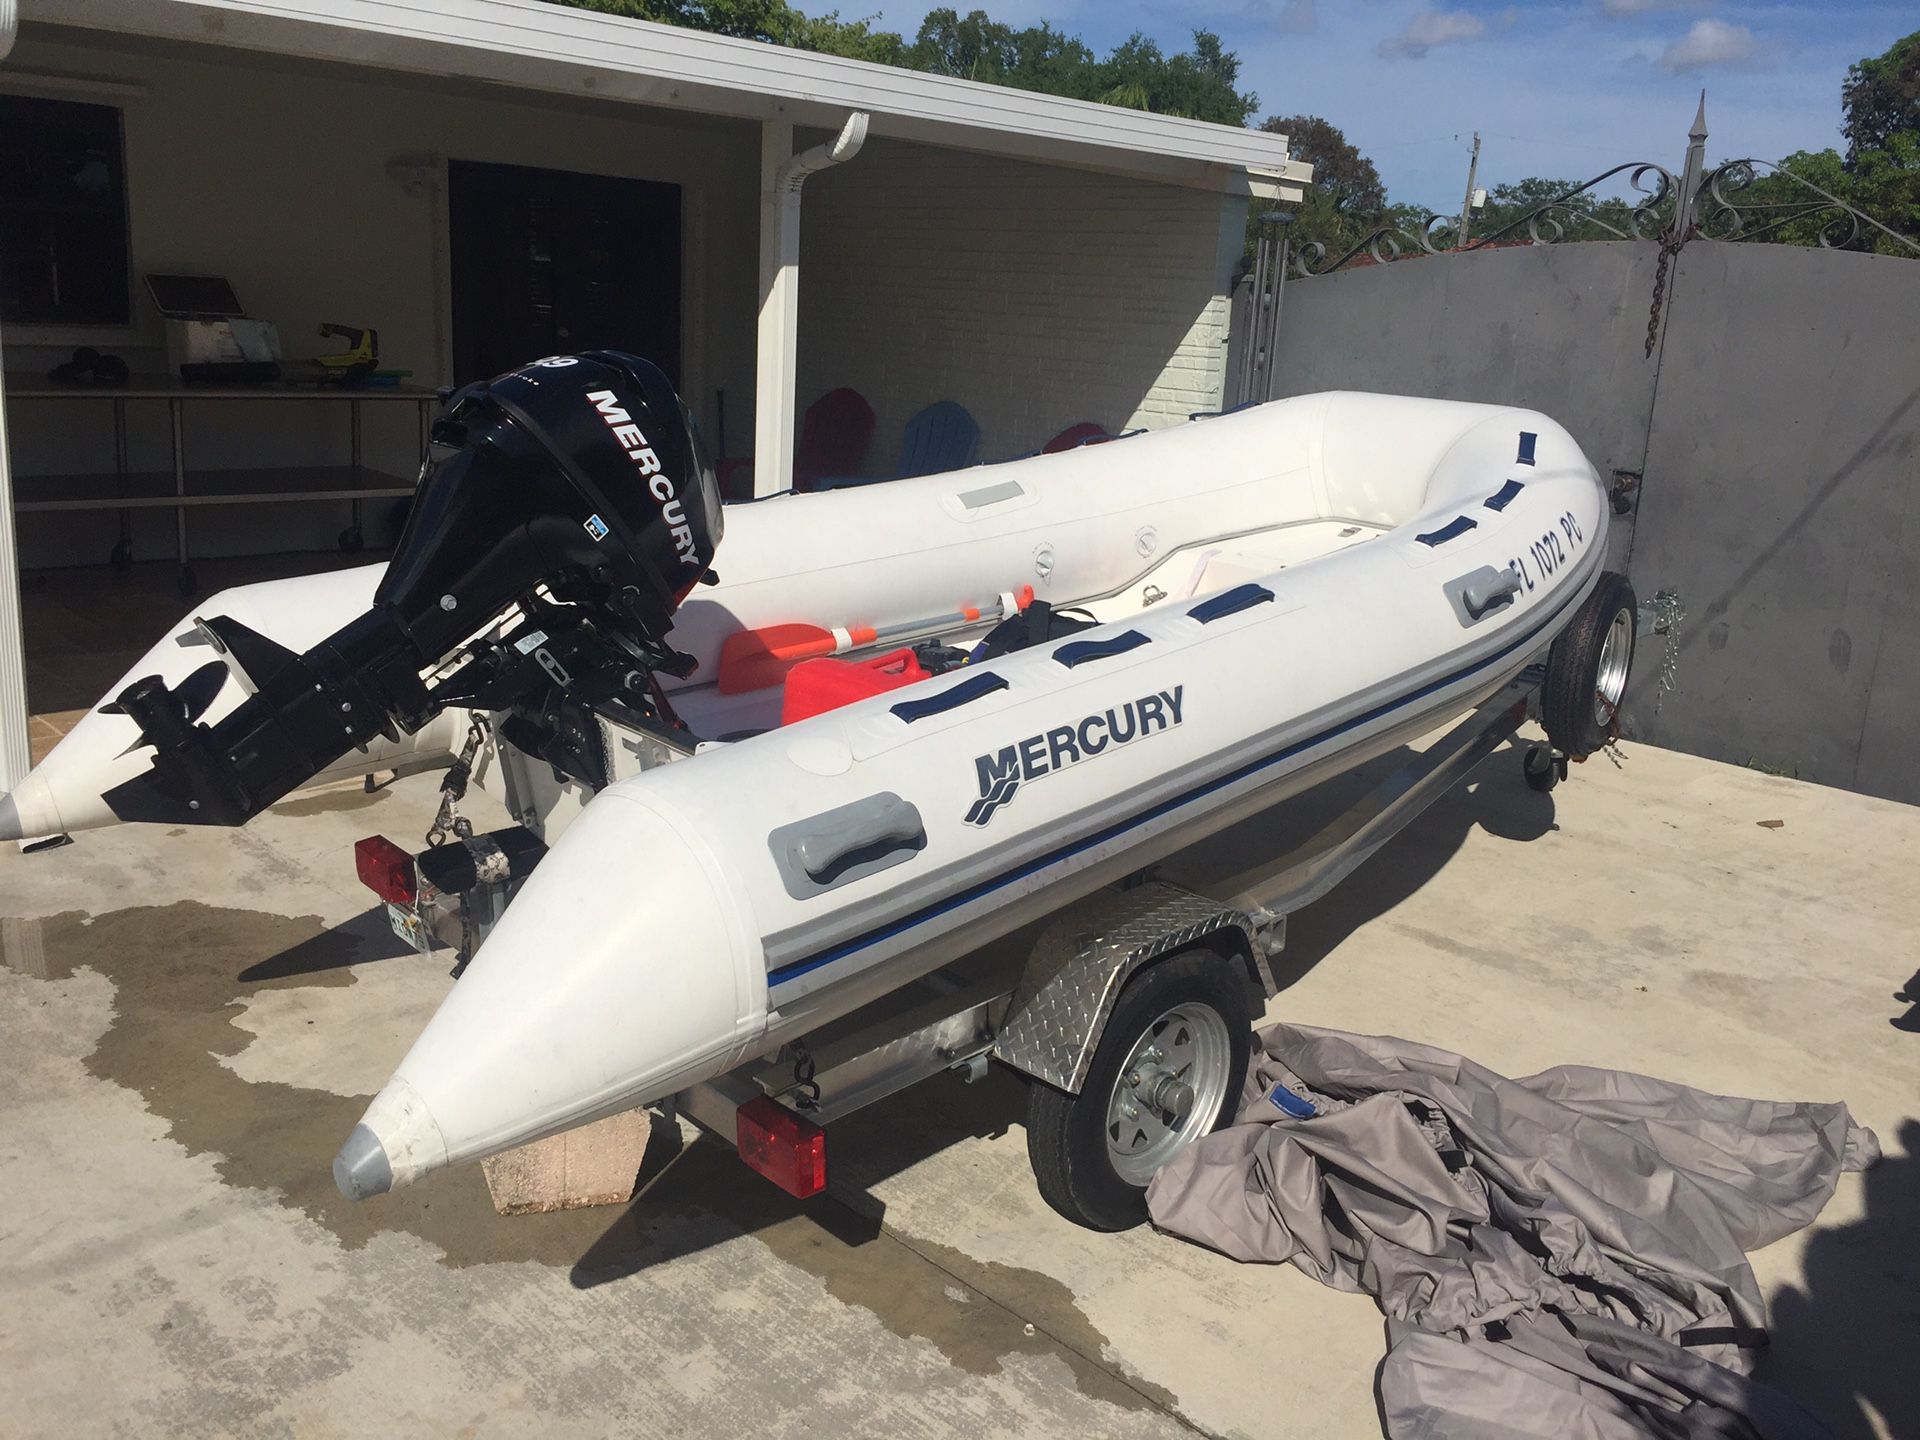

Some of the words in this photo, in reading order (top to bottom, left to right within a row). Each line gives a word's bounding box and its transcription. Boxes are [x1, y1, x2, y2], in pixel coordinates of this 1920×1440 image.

[586, 390, 700, 565] MERCURY
[1529, 530, 1566, 581] 1072
[1559, 509, 1583, 551] PC
[968, 684, 1183, 806] MERCURY
